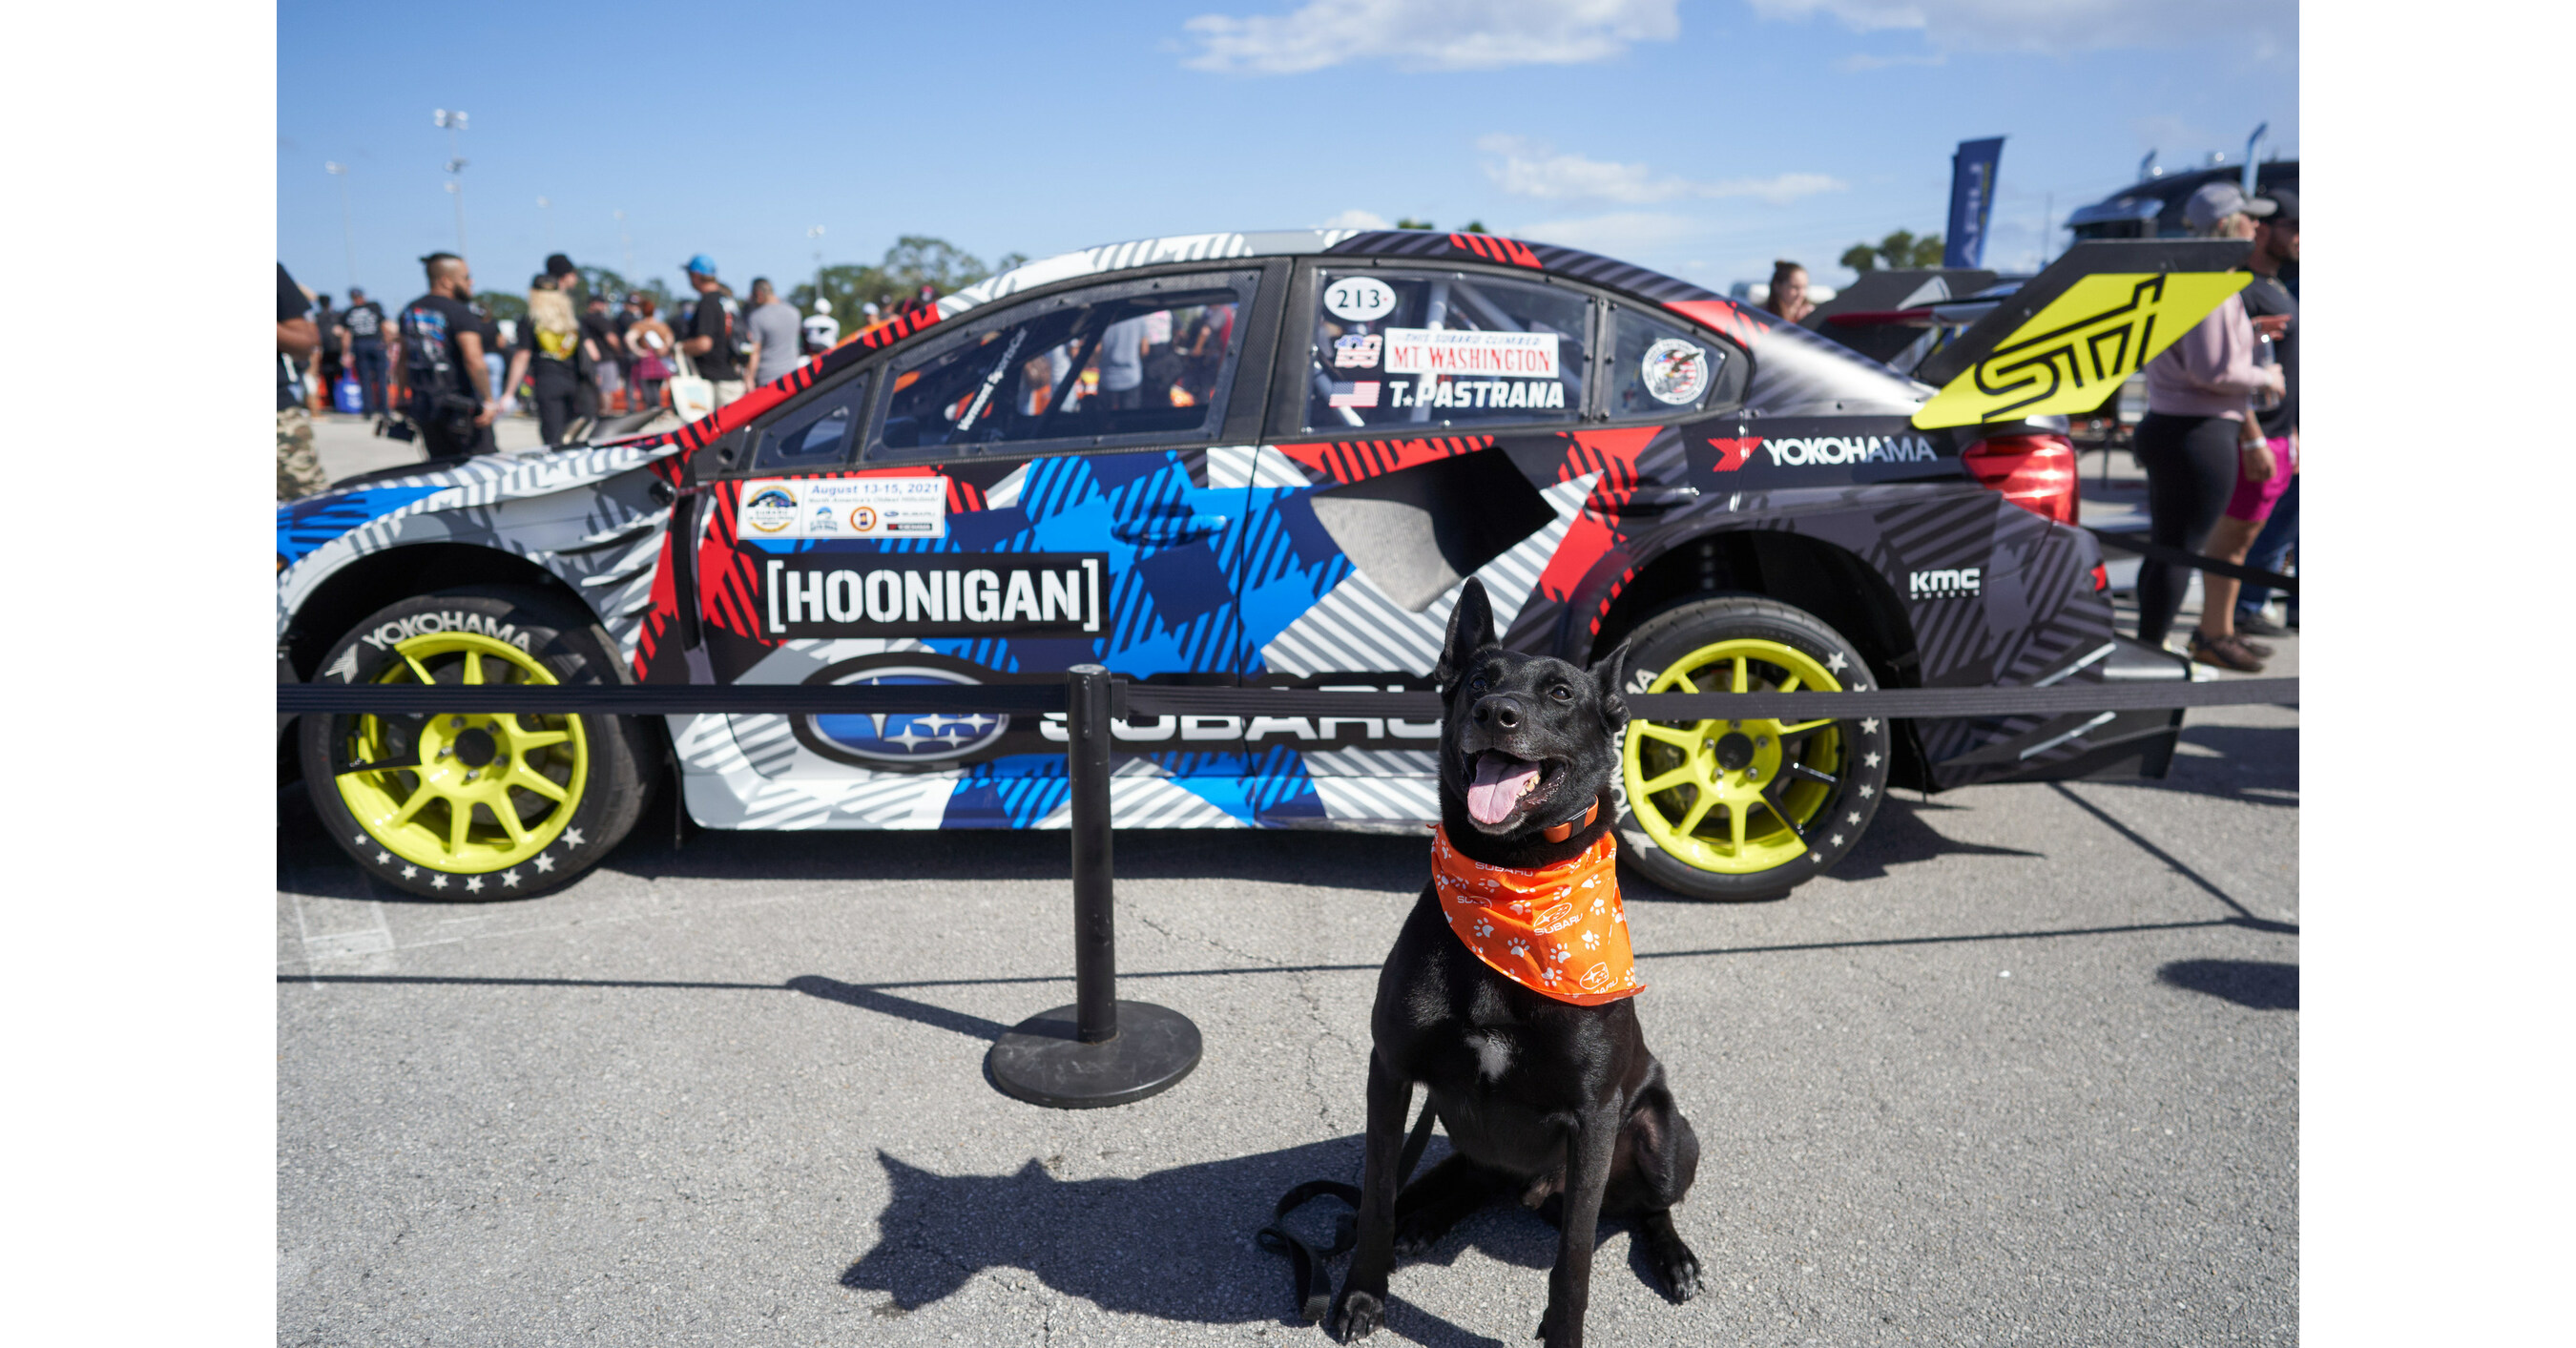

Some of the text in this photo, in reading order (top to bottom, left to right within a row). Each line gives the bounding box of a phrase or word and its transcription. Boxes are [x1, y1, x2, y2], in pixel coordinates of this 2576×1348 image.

[1337, 289, 1381, 308] 213
[1428, 346, 1551, 372] WASHINGTON
[1762, 436, 1938, 467] YOKOHAMA
[812, 484, 858, 496] August
[907, 483, 939, 493] 2021
[361, 611, 531, 653] YOKOHAMA
[1533, 913, 1583, 936] SUBARU
